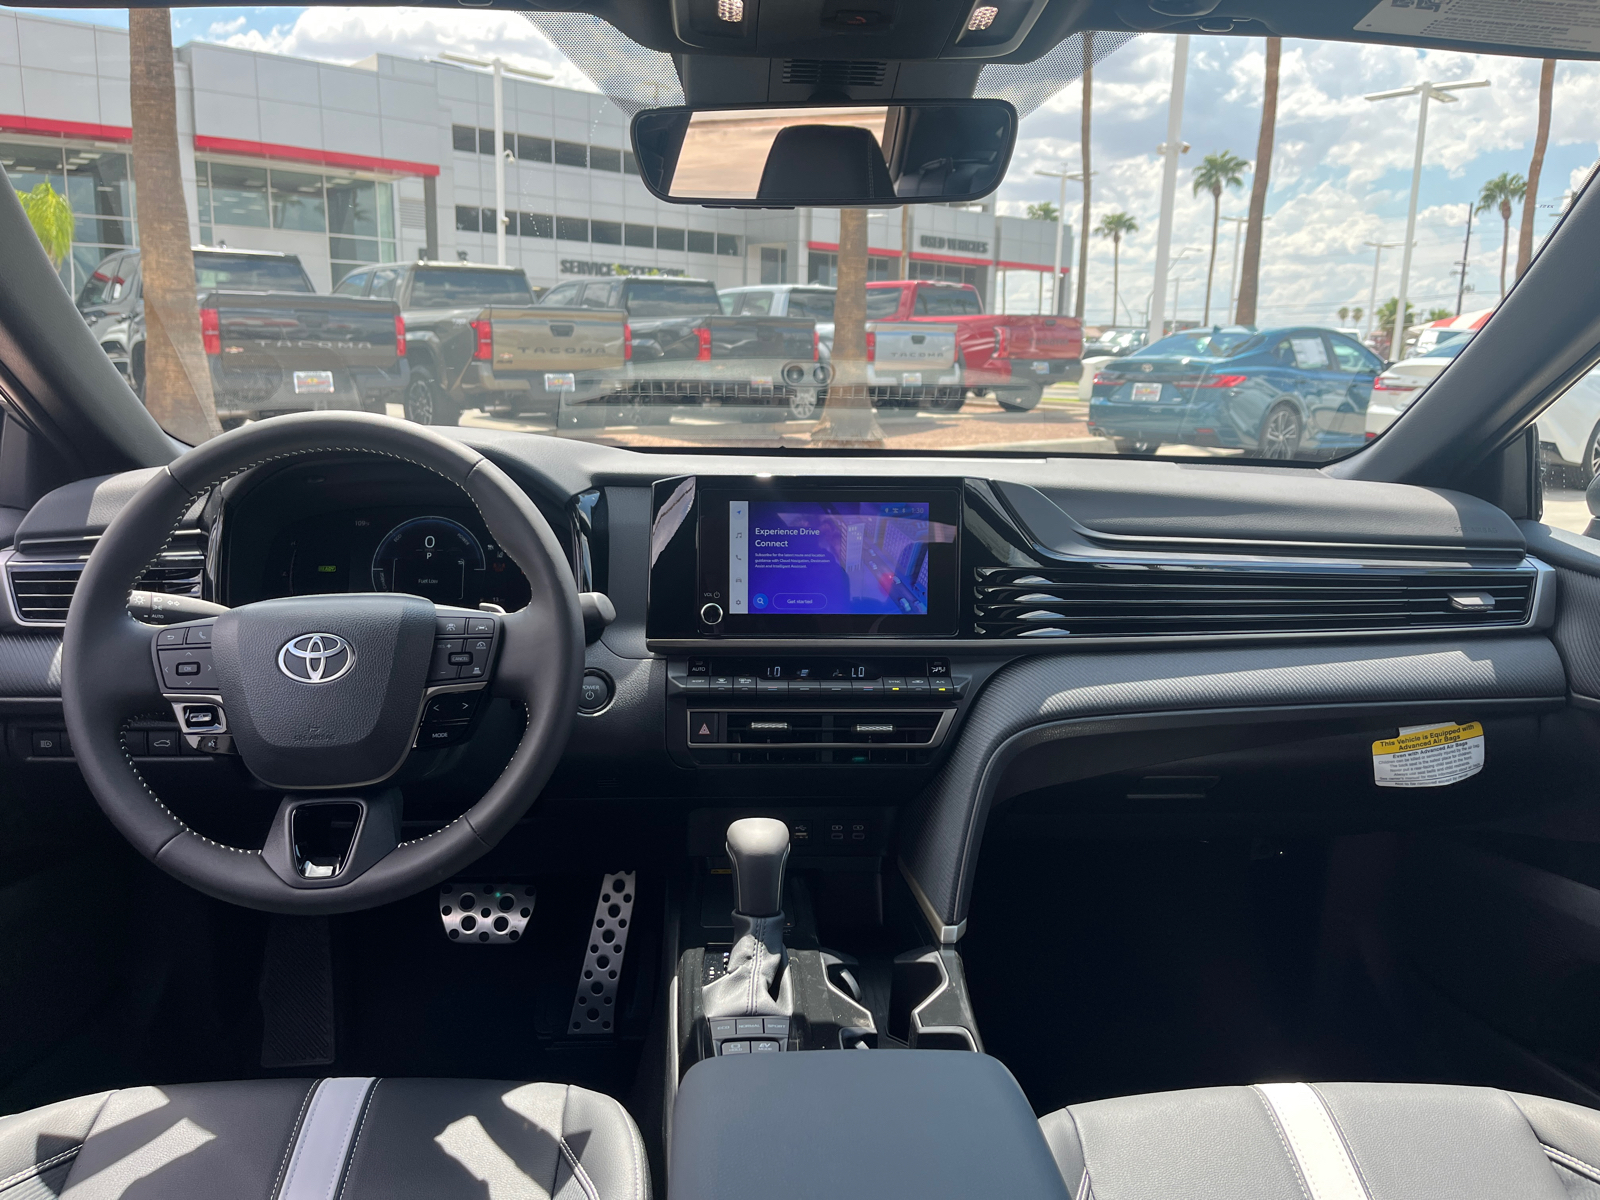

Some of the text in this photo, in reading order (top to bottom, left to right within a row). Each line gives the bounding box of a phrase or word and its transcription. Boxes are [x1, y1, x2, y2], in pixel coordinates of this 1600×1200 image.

[560, 260, 615, 276] SERVICE
[254, 339, 372, 350] TACOMA
[518, 346, 606, 354] TACOMA
[755, 528, 798, 536] Experience
[424, 536, 435, 548] 0
[852, 666, 864, 677] LO
[1397, 736, 1420, 744] Vehicle
[1430, 728, 1460, 738] Equipped
[1462, 724, 1474, 732] with
[1399, 740, 1431, 750] Advanced
